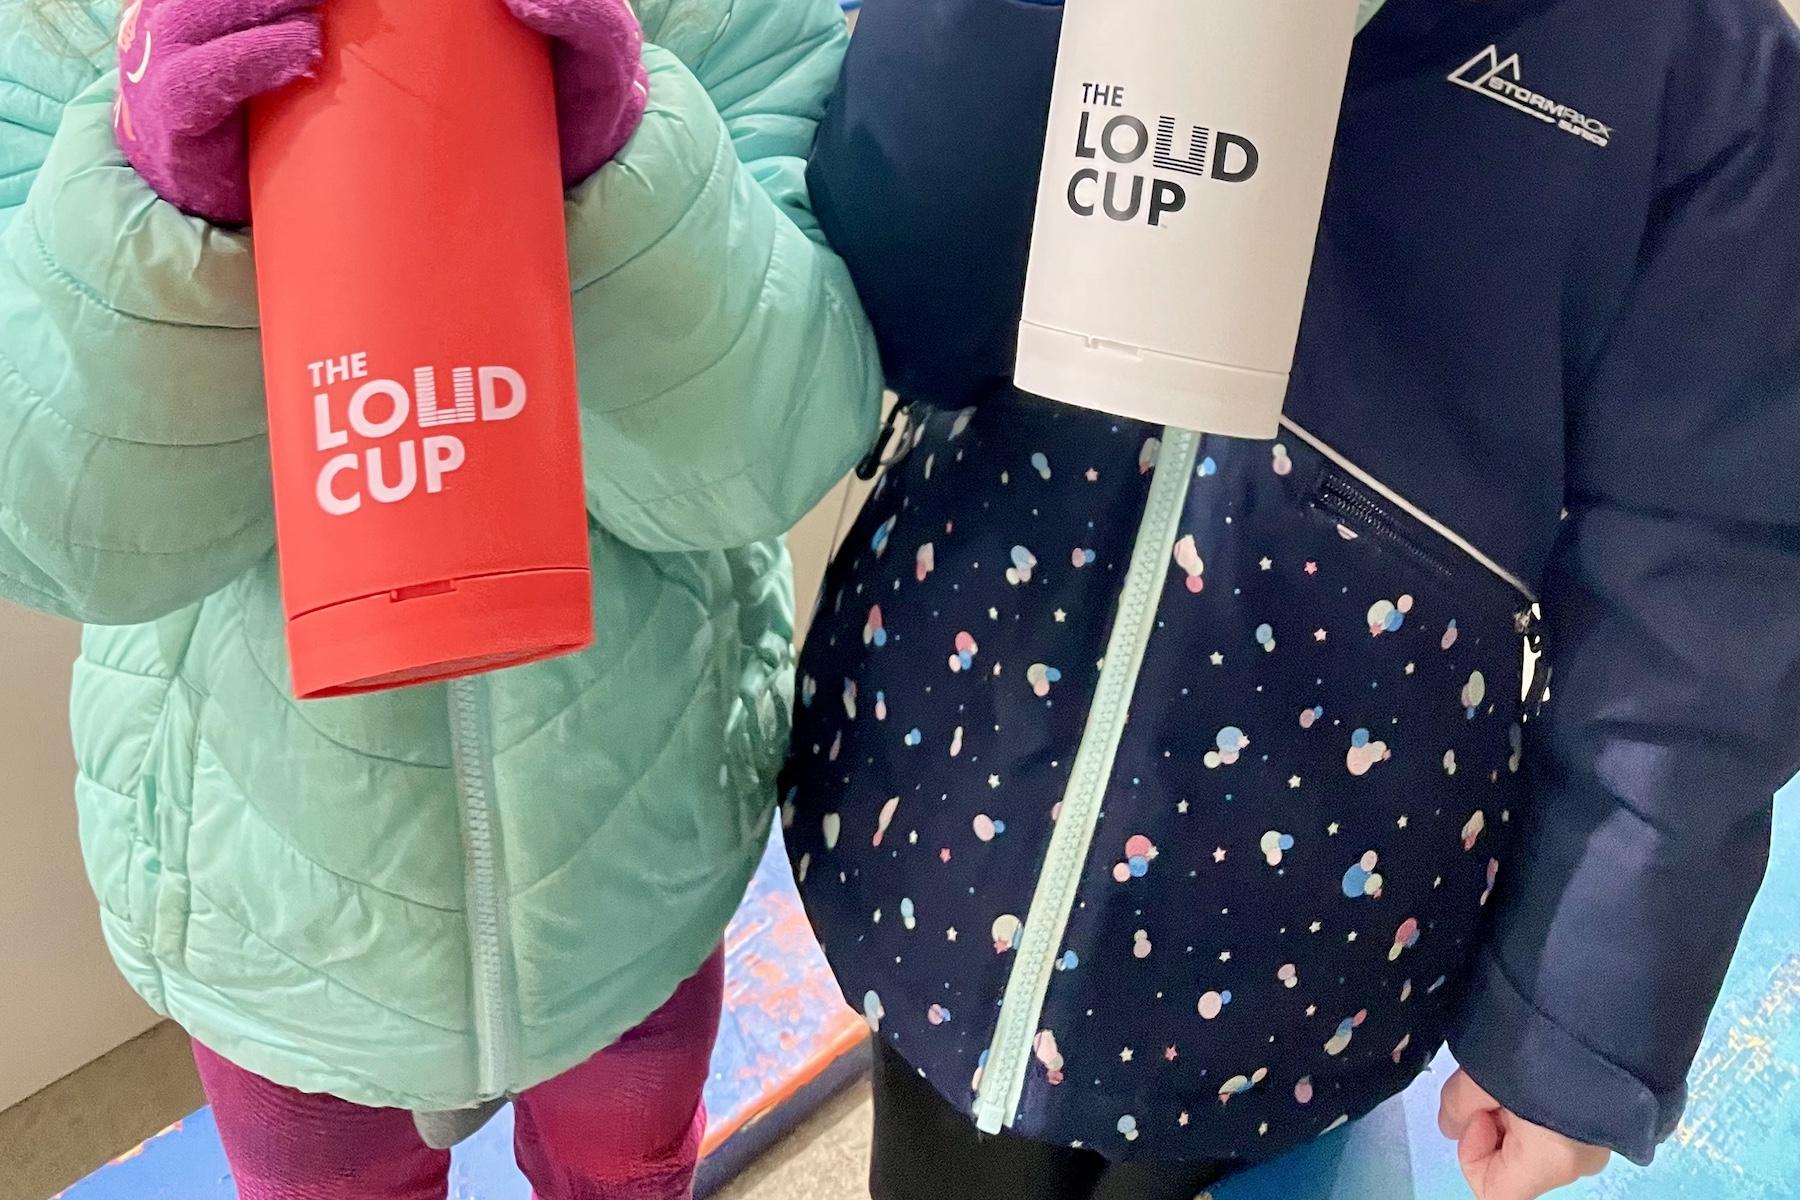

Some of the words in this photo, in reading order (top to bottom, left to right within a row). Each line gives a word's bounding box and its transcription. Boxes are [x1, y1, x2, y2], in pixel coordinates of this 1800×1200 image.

[1082, 82, 1125, 107] THE
[1075, 111, 1259, 184] LOUD
[1066, 167, 1187, 226] CUP
[307, 351, 368, 388] THE
[312, 365, 527, 451] LOUD
[315, 434, 466, 516] CUP
